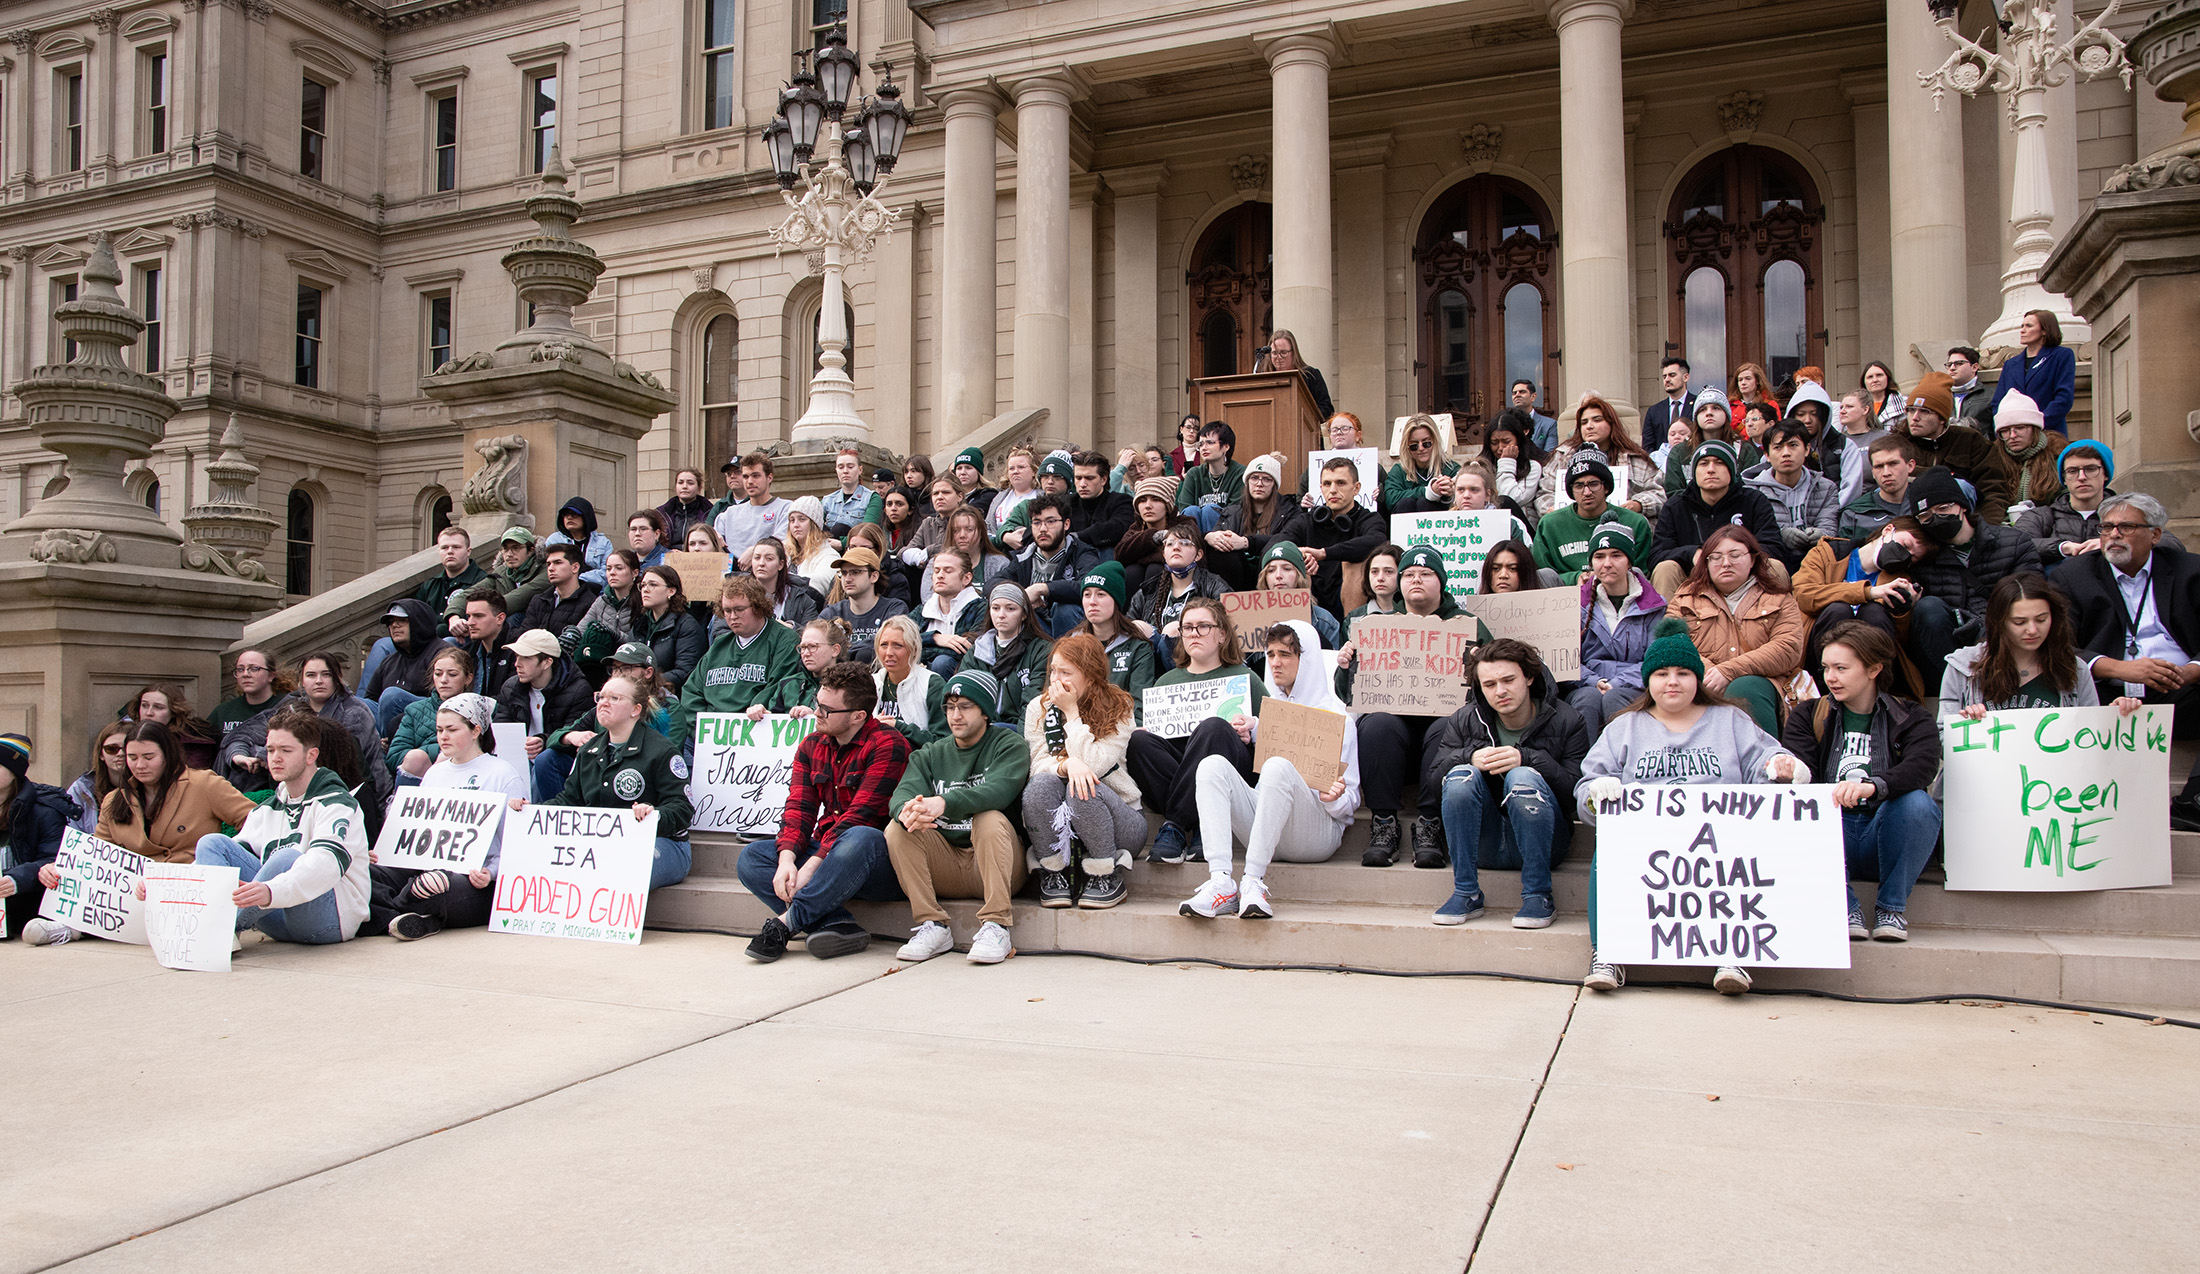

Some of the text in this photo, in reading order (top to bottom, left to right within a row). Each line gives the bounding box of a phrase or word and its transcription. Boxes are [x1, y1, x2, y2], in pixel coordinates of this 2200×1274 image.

[1416, 516, 1480, 530] We are just
[1407, 533, 1483, 547] kids trying to
[1442, 549, 1456, 561] nd
[1084, 575, 1106, 586] SMBCS
[1447, 569, 1478, 579] come
[1222, 591, 1310, 613] OUR BLOOD
[1473, 598, 1502, 621] 46
[1504, 601, 1533, 622] days
[1537, 598, 1548, 615] of
[1552, 598, 1579, 612] 2023
[1503, 624, 1529, 634] MASS
[1542, 631, 1551, 640] of
[1555, 628, 1576, 639] 2023
[1358, 628, 1470, 657] WHAT IF IT
[738, 663, 767, 683] STATE
[1359, 651, 1400, 671] WAS
[1401, 656, 1423, 669] YOUR
[1145, 678, 1227, 697] I'VE BEEN THROUGH
[1360, 674, 1382, 688] THIS
[1386, 674, 1404, 688] HAS
[1408, 675, 1419, 689] TO
[1145, 688, 1219, 705] THIS TWICE
[1361, 692, 1395, 706] DEMAND
[1398, 693, 1429, 707] CHANGE
[1144, 703, 1211, 719] NO ONE SHOULD
[1144, 718, 1163, 726] EVER
[698, 718, 815, 747] FUCK YOU
[1165, 720, 1204, 736] ONC
[1262, 723, 1324, 750] WE SHOULDN'T
[1950, 716, 2017, 752] It
[1644, 746, 1683, 757] MICHIGAN
[1634, 753, 1722, 779] SPARTANS
[620, 777, 637, 791] MSU
[2019, 764, 2118, 816] been
[400, 797, 497, 826] HOW MANY
[1656, 788, 1687, 817] IS
[1702, 791, 1765, 820] WHY
[528, 809, 624, 838] AMERICA
[394, 828, 478, 862] MORE?
[1688, 822, 1718, 854] A
[2024, 817, 2114, 878] ME
[66, 829, 155, 877] 67 SHOOTIN
[551, 846, 596, 870] IS A
[56, 852, 75, 870] IN
[76, 860, 94, 880] 45
[146, 866, 193, 888] THOUGHTS
[1640, 850, 1776, 890] SOCIAL
[89, 886, 130, 914] WILL
[163, 889, 205, 914] PRAYERS
[496, 874, 644, 929] LOADED GUN
[1647, 890, 1768, 921] WORK
[56, 897, 125, 933] IT END?
[174, 911, 200, 937] AND
[512, 918, 627, 941] PRAY FOR MICHIGAN STATE
[1651, 922, 1780, 962] MAJOR
